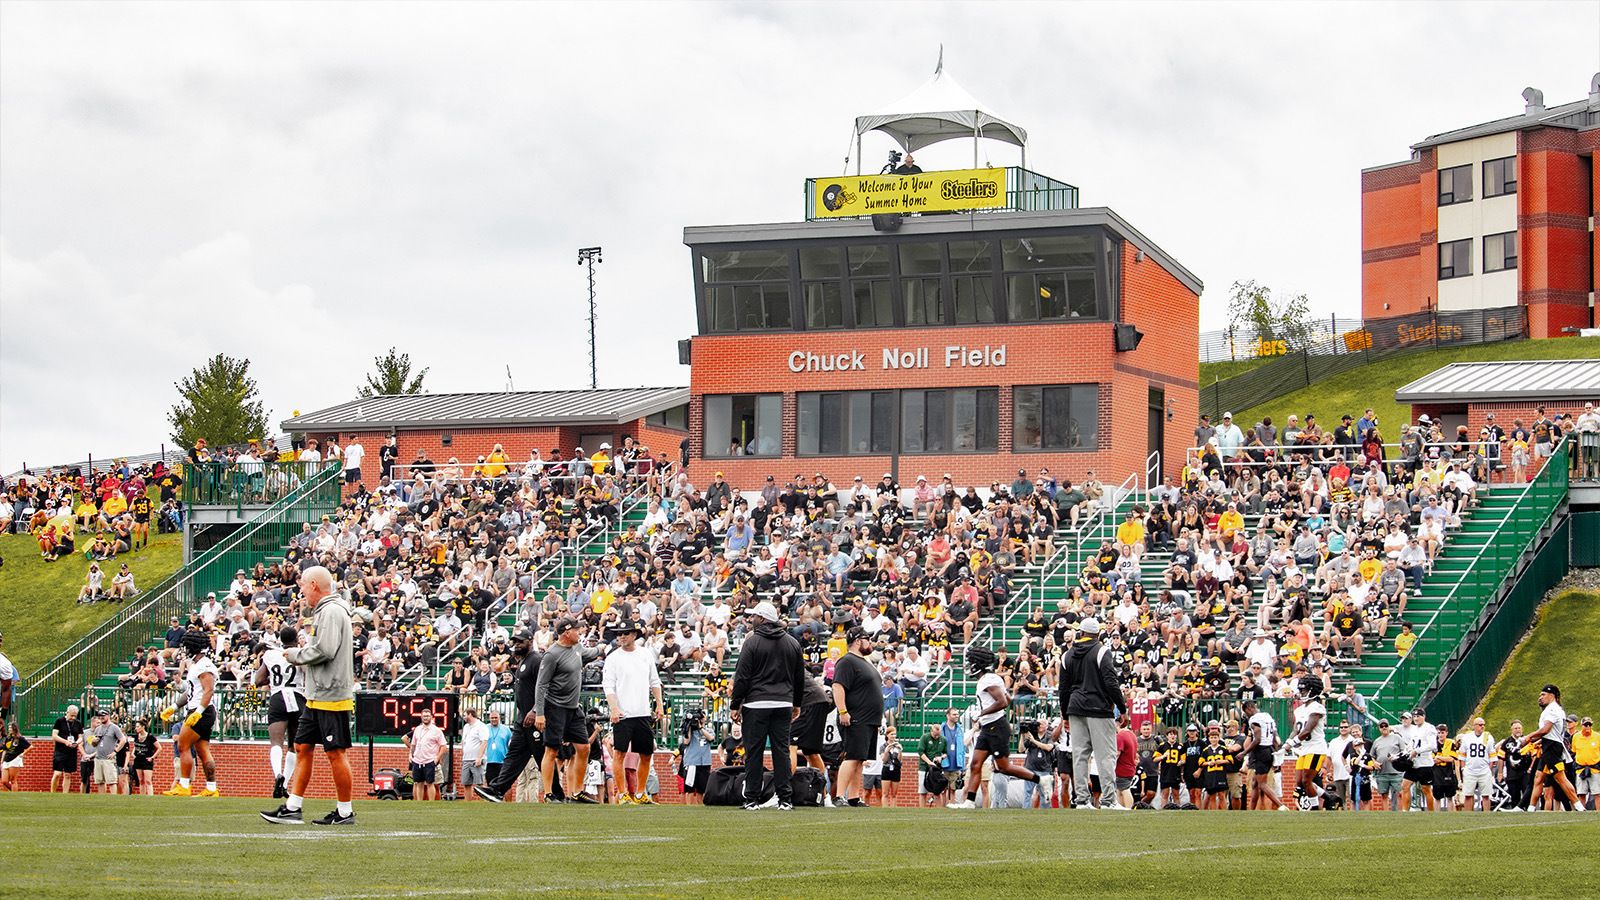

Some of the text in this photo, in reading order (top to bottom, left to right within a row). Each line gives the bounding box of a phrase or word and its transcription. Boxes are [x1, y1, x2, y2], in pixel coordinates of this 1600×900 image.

[859, 177, 933, 193] Welcome To Your
[941, 178, 998, 200] Steelers
[865, 194, 927, 209] Summer Home
[788, 344, 1007, 373] Chuck Noll Field
[136, 503, 148, 514] 39
[1367, 606, 1380, 619] 55
[810, 652, 819, 663] 90
[1147, 650, 1160, 664] 90
[270, 664, 297, 688] 82
[1132, 698, 1149, 714] 22
[1165, 748, 1179, 764] 19
[1469, 743, 1486, 758] 88
